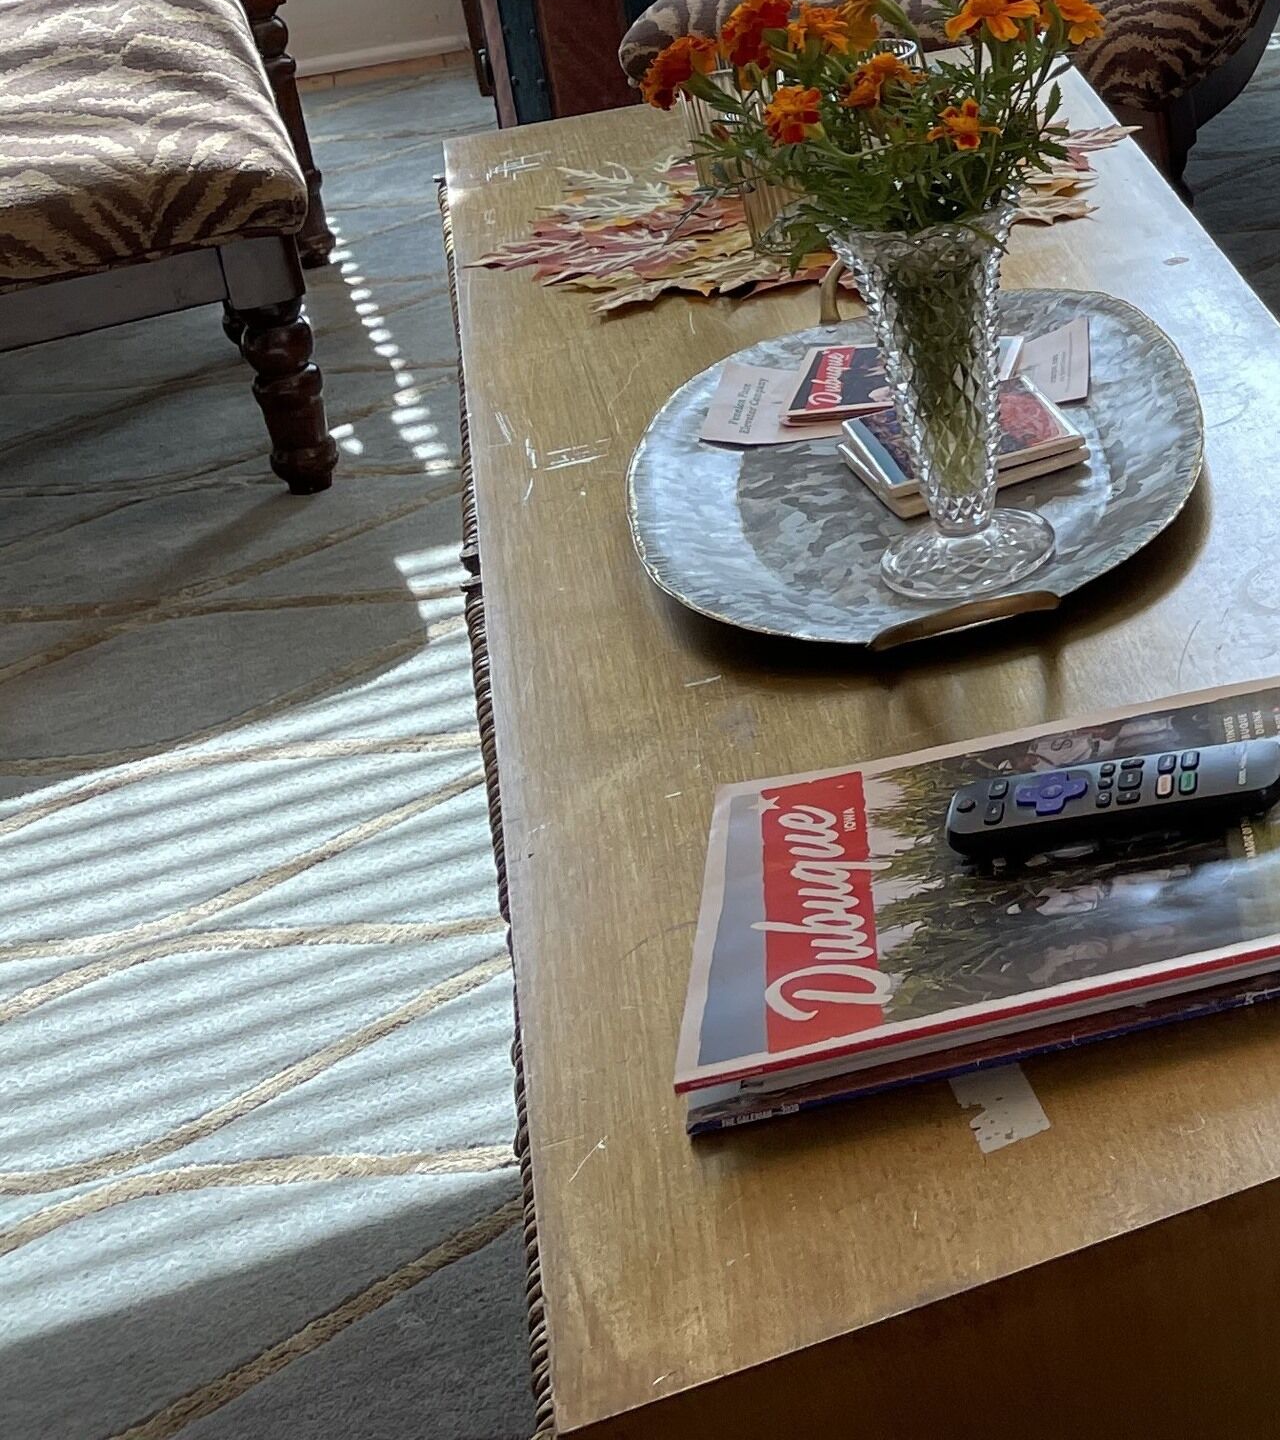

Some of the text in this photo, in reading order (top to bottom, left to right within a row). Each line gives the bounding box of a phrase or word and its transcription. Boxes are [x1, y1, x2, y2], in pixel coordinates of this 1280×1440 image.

[751, 377, 769, 409] Company
[808, 352, 851, 406] Dubuque
[1238, 713, 1251, 740] BUQUE
[1252, 710, 1264, 735] DRINK
[843, 807, 856, 832] IOWA
[750, 804, 894, 1022] Dubuque
